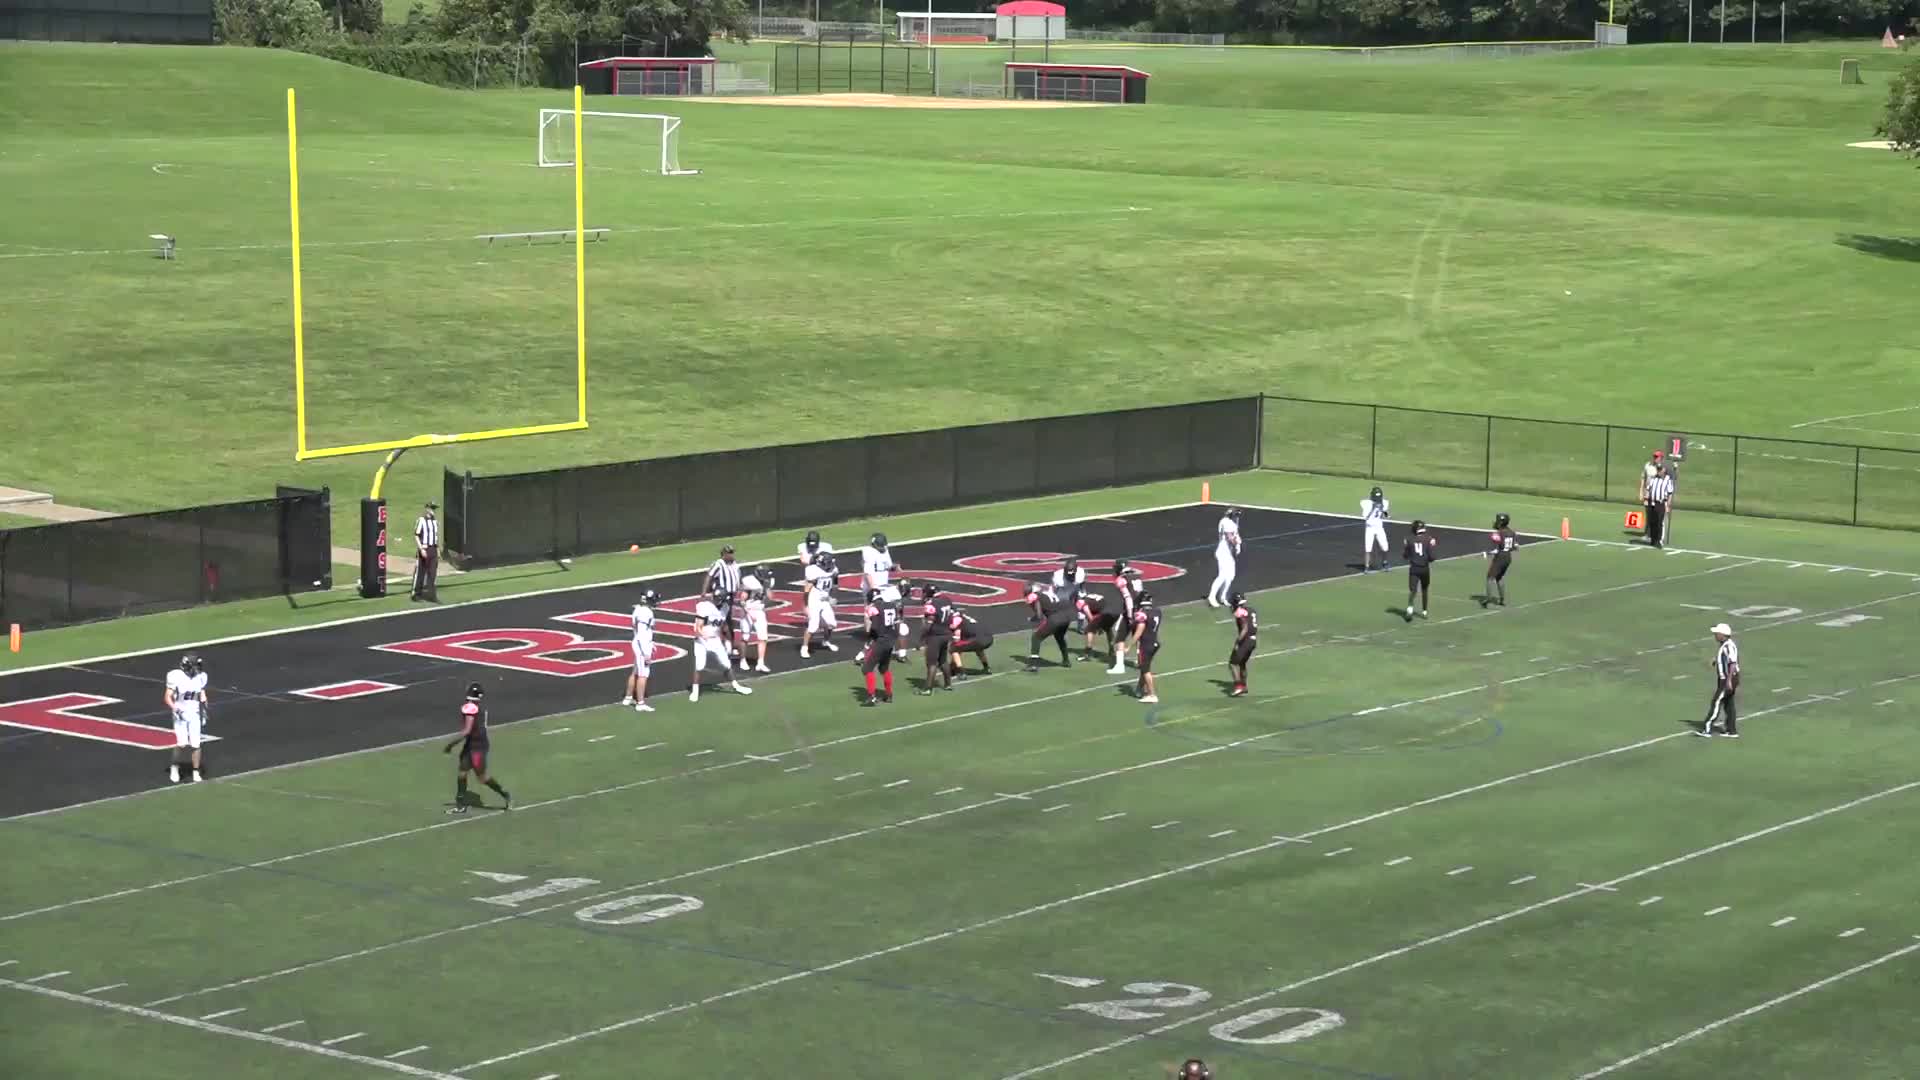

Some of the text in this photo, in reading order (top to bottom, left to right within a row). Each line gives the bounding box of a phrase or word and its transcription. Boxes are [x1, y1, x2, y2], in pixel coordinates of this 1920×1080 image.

[1628, 513, 1638, 526] G
[1413, 541, 1424, 557] 4
[1060, 982, 1347, 1044] 20
